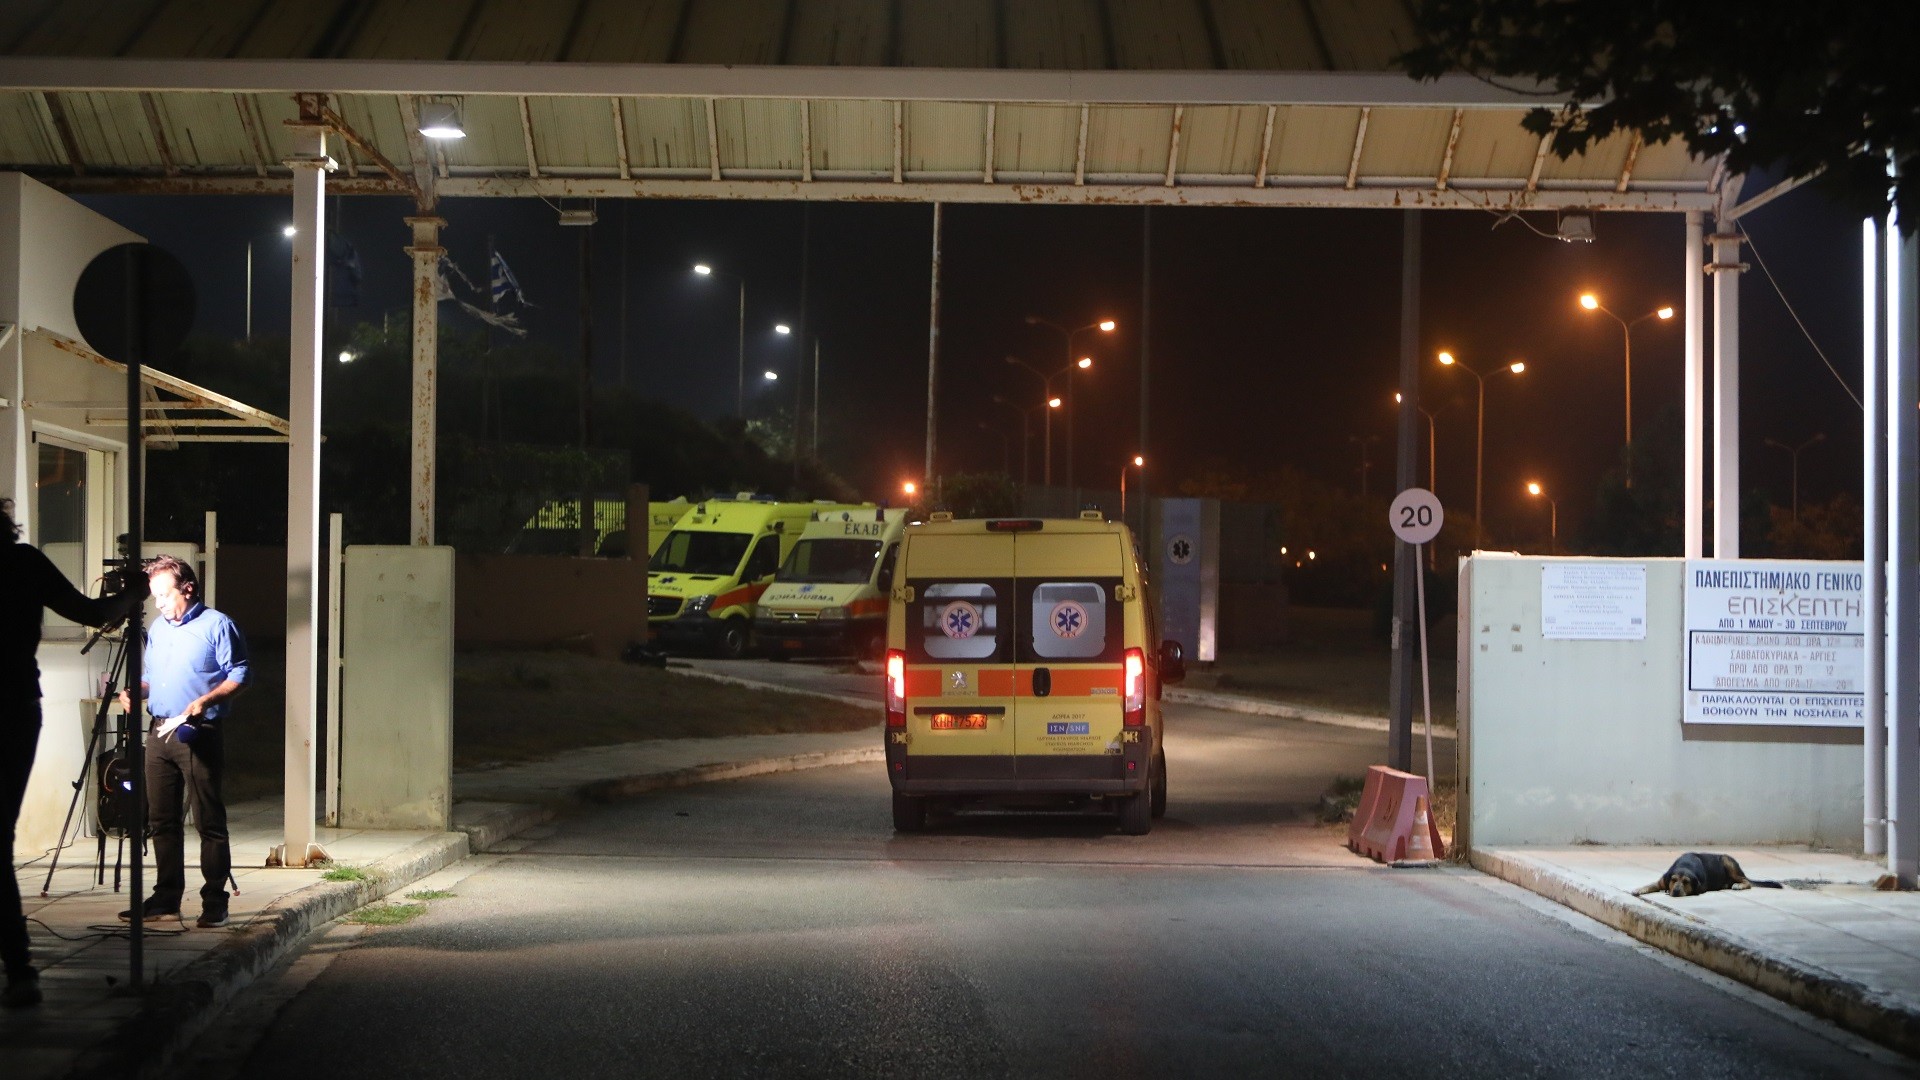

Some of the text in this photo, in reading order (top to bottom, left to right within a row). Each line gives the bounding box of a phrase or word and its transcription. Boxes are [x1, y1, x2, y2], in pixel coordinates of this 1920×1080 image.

[1400, 505, 1433, 528] 20
[1695, 569, 1862, 591] ΠΑΝΕΠΙΣΤΗΜΙΑΚΟ ΓΕΝΙΚΟ
[1728, 596, 1862, 617] ΕΠΙΣΚΕΠΤΗ
[1718, 618, 1735, 629] ΑΠΟ
[1739, 618, 1744, 629] 1
[1748, 618, 1774, 629] ΜΑΙΟΥ
[1785, 619, 1796, 630] 30
[1801, 619, 1848, 631] ΣΕΠΤΕΒΡΙΟΥ
[1756, 635, 1780, 646] ΜΟΝΟ
[1785, 636, 1801, 647] ΑΠΟ
[1730, 649, 1799, 661] ΣΑΒΒΑΤΟΚΥΡΙΑΚΑ
[1810, 651, 1836, 662] ΑΡΓΙΕΣ
[1752, 663, 1769, 674] ΑΠΟ
[1773, 664, 1789, 675] ΩΡΑ
[1716, 676, 1759, 688] ΑΠΟΓΕΥΜΑ
[1764, 677, 1780, 688] ΑΠΟ
[1702, 695, 1864, 707] ΠΑΡΑΚΑΛΟΥΝΤΑΙ ΟΙ ΕΠΙΣΚΕΠΤΕΣ
[1702, 707, 1863, 718] ΒΟΗΘΟΥΝ ΤΗΝ ΝΟΣΗΛΕΙΑ Κ
